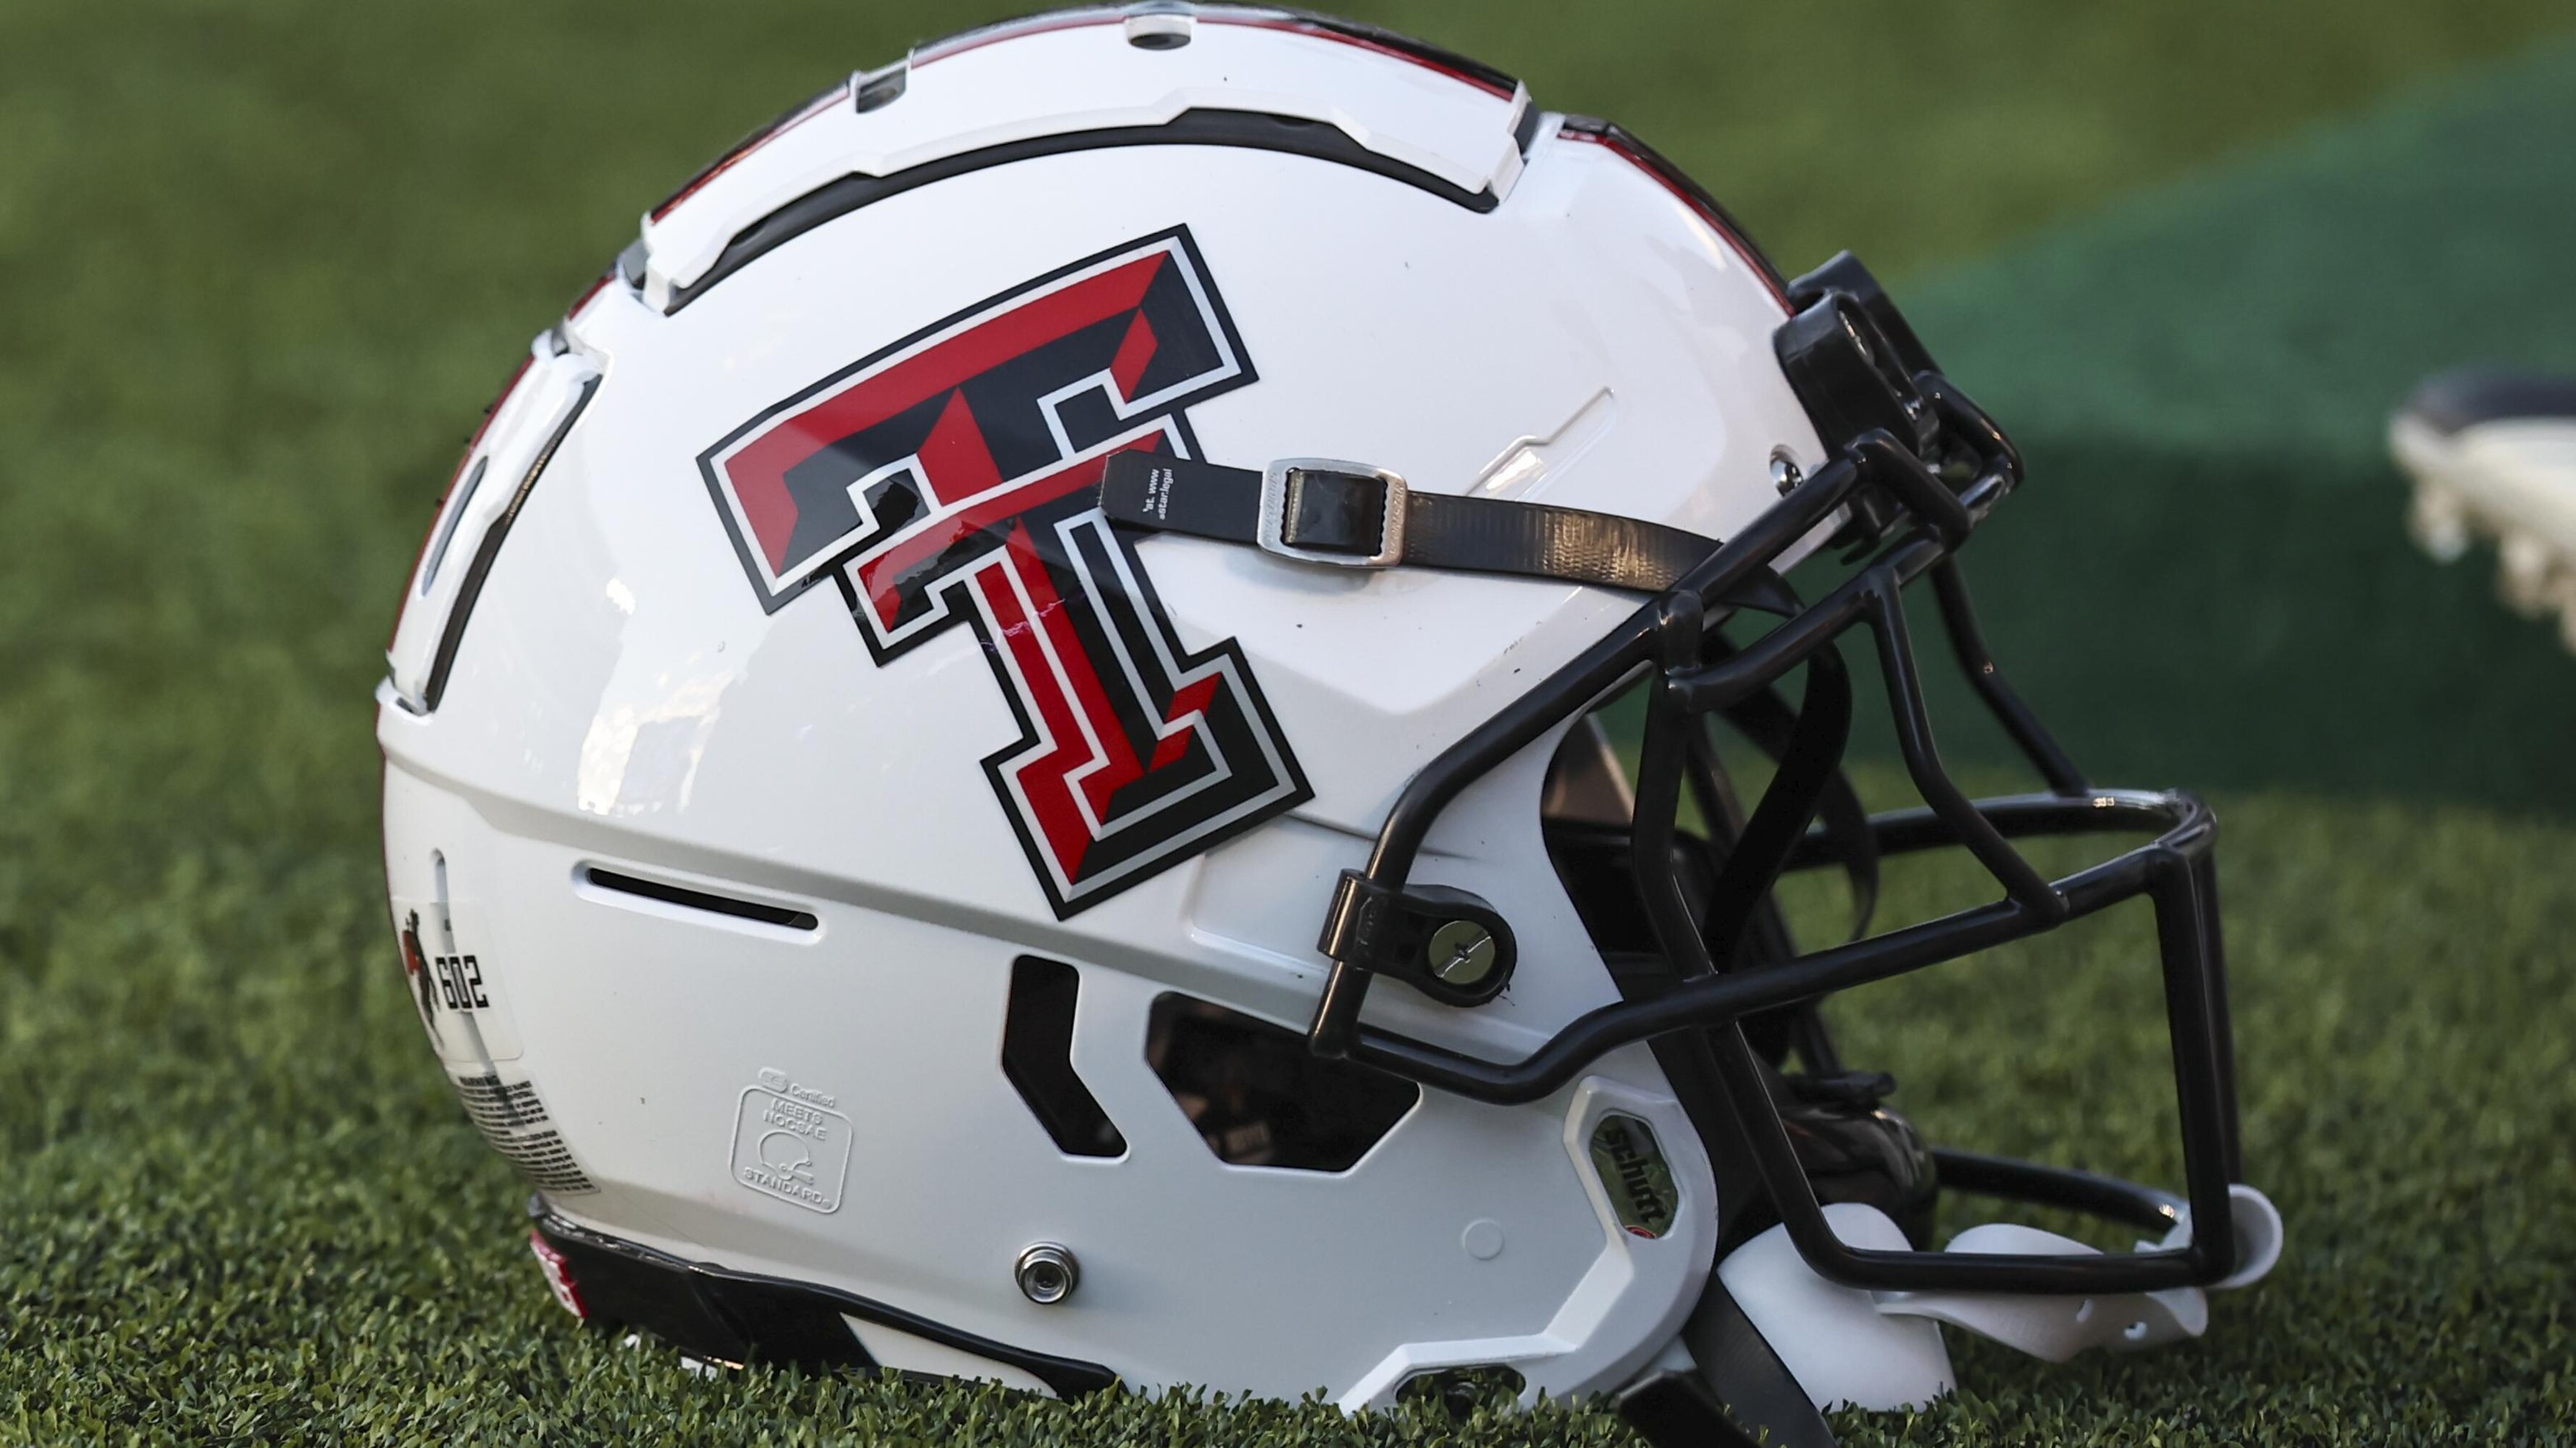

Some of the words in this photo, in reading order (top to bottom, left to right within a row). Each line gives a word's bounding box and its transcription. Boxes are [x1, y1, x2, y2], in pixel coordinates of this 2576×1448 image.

[1148, 468, 1160, 494] www
[435, 954, 489, 1010] 602
[762, 1108, 828, 1141] NOCSAE
[771, 1098, 824, 1125] MEETS
